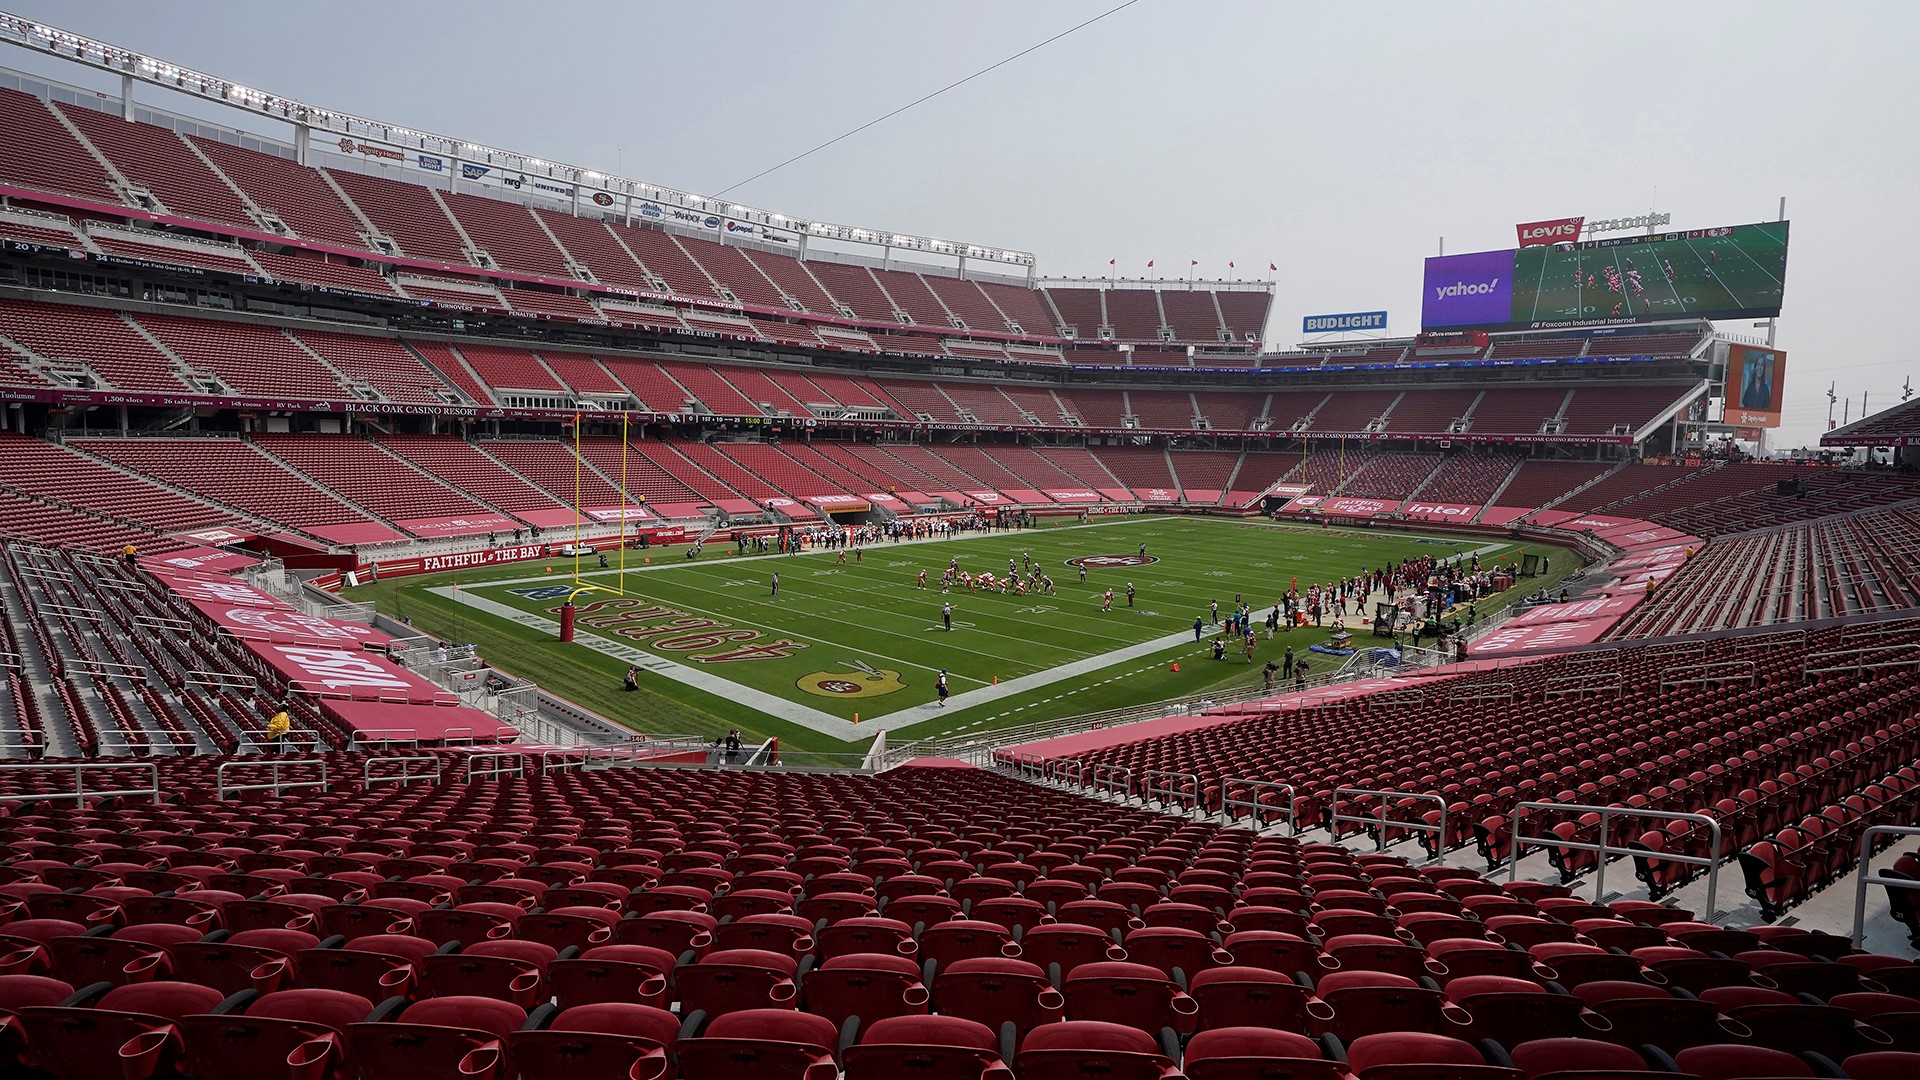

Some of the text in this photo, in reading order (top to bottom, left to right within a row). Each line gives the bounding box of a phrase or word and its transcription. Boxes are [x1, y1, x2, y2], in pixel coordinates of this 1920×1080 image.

[359, 145, 384, 157] Dignity
[420, 161, 441, 170] LIGHT
[464, 167, 484, 177] SAP
[504, 177, 521, 189] nrg
[535, 183, 565, 194] UNITED
[674, 210, 701, 223] YAHOO!
[1588, 212, 1671, 234] STADIUM
[736, 225, 752, 234] pepsi
[15, 242, 29, 251] 20
[95, 254, 108, 262] 34
[1436, 278, 1499, 300] yahoo!
[606, 287, 744, 310] 5-TIME SUPER BOWL CHAMPIONS
[436, 303, 473, 312] TURNOVERS
[509, 311, 538, 319] PENALTIES
[578, 318, 608, 327] POSSESSION
[1572, 319, 1606, 327] Industrial
[1608, 317, 1636, 325] Internet
[676, 328, 695, 336] GAME
[1, 390, 36, 400] Tuolumne
[104, 395, 143, 404] 1,500 slots
[174, 398, 191, 406] table
[192, 400, 213, 408] games
[345, 403, 380, 413] BLACK
[381, 405, 404, 413] OAK
[406, 406, 442, 415] CASINO
[443, 407, 478, 416] RESORT
[1408, 503, 1470, 516] intel
[1332, 516, 1355, 525] 49ERS
[424, 545, 541, 571] FAITHFUL THE BAY
[587, 640, 651, 662] TAKES
[273, 646, 411, 690] VISA
[632, 735, 645, 743] 146
